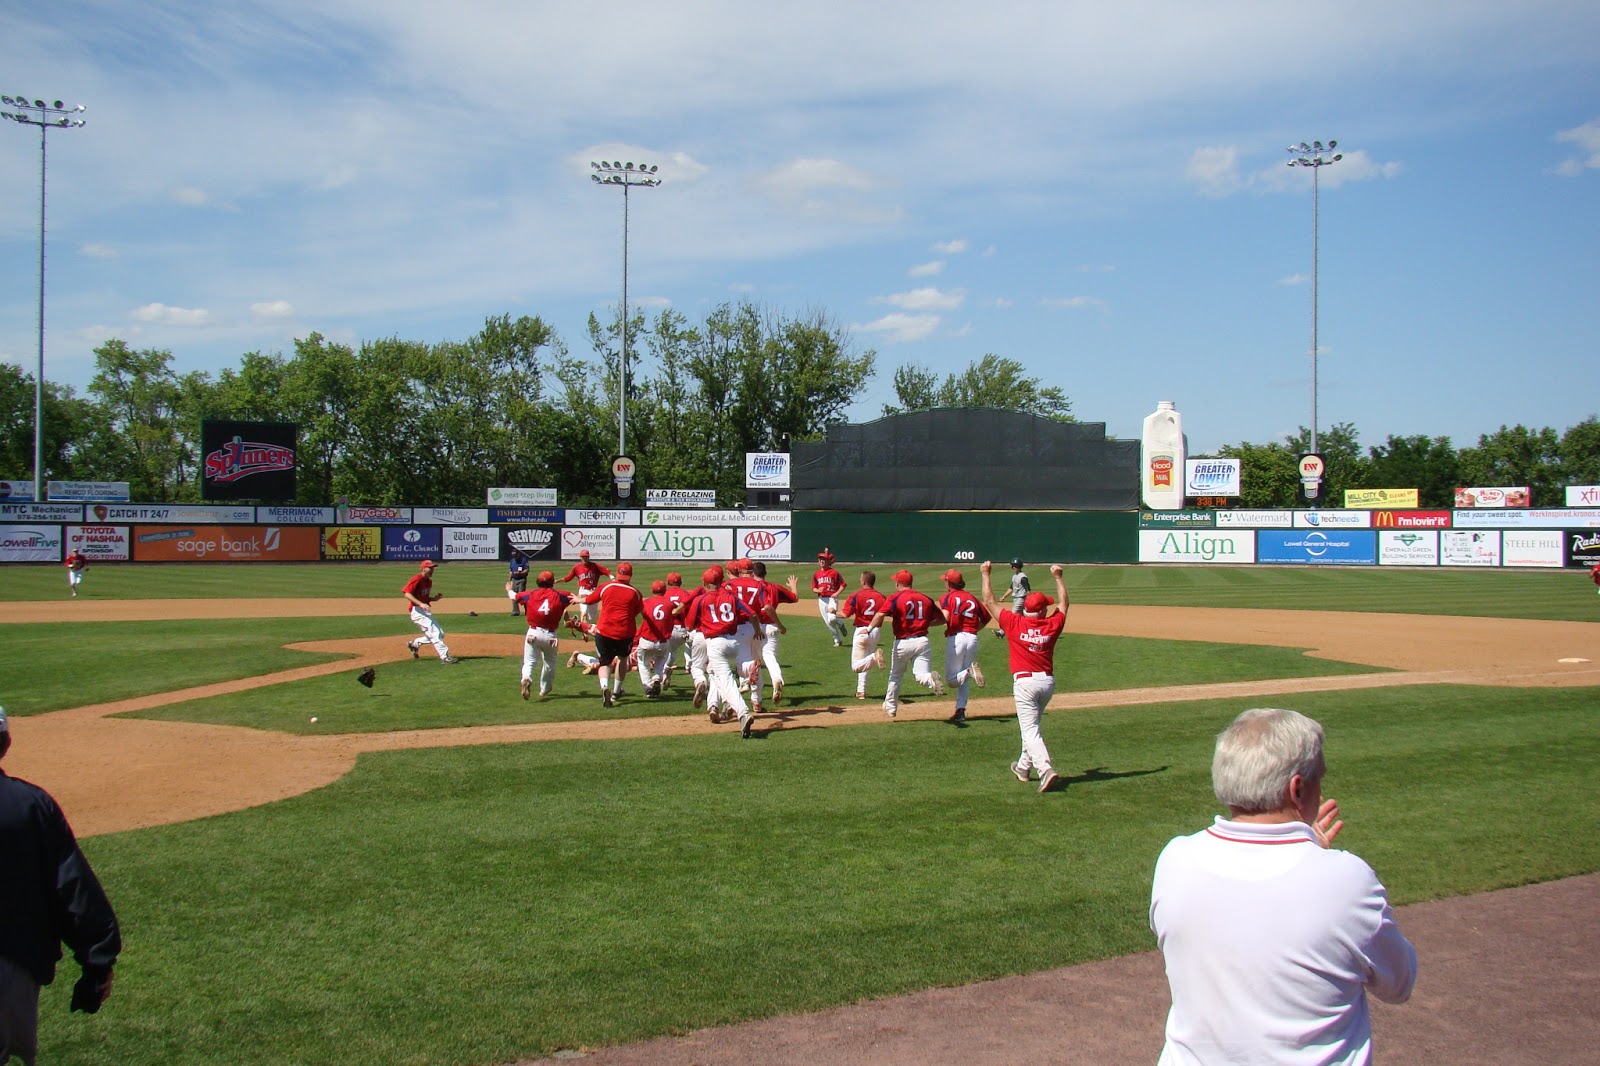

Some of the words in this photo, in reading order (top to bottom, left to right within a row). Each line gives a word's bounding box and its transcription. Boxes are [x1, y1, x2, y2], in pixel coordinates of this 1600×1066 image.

[752, 466, 784, 474] LOWELL
[1195, 465, 1232, 473] GREATER
[1194, 474, 1231, 483] LOWELL
[536, 492, 554, 500] living
[1581, 488, 1600, 504] xfi
[1216, 497, 1226, 506] PM
[2, 506, 27, 514] MTC
[32, 506, 81, 514] Mechanical
[110, 510, 138, 518] CATCH
[140, 510, 148, 518] IT
[151, 510, 169, 518] 24/7
[268, 508, 324, 516] MERRIMACK
[350, 509, 366, 518] Jay
[368, 508, 395, 517] Gee's
[662, 514, 686, 522] Lahey
[686, 514, 720, 522] Hospital
[1154, 513, 1190, 522] Enterprise
[1192, 512, 1211, 520] Bank
[1236, 512, 1289, 522] Watermark
[1398, 516, 1412, 526] i'm
[1412, 516, 1437, 526] lovin'
[454, 532, 487, 540] Woburn
[508, 530, 553, 542] GERVAIS
[746, 532, 774, 550] AAA
[177, 540, 216, 556] sage
[221, 536, 260, 552] bank
[445, 544, 468, 554] Daily
[472, 544, 496, 554] Times
[640, 530, 715, 558] Align
[1158, 532, 1236, 560] Align
[1540, 540, 1560, 548] HILL
[954, 551, 975, 560] 400
[736, 586, 759, 605] 17
[538, 599, 550, 615] 4
[864, 598, 876, 616] 2
[905, 601, 924, 620] 21
[954, 597, 976, 618] 12
[653, 604, 664, 621] 6
[708, 604, 735, 623] 18
